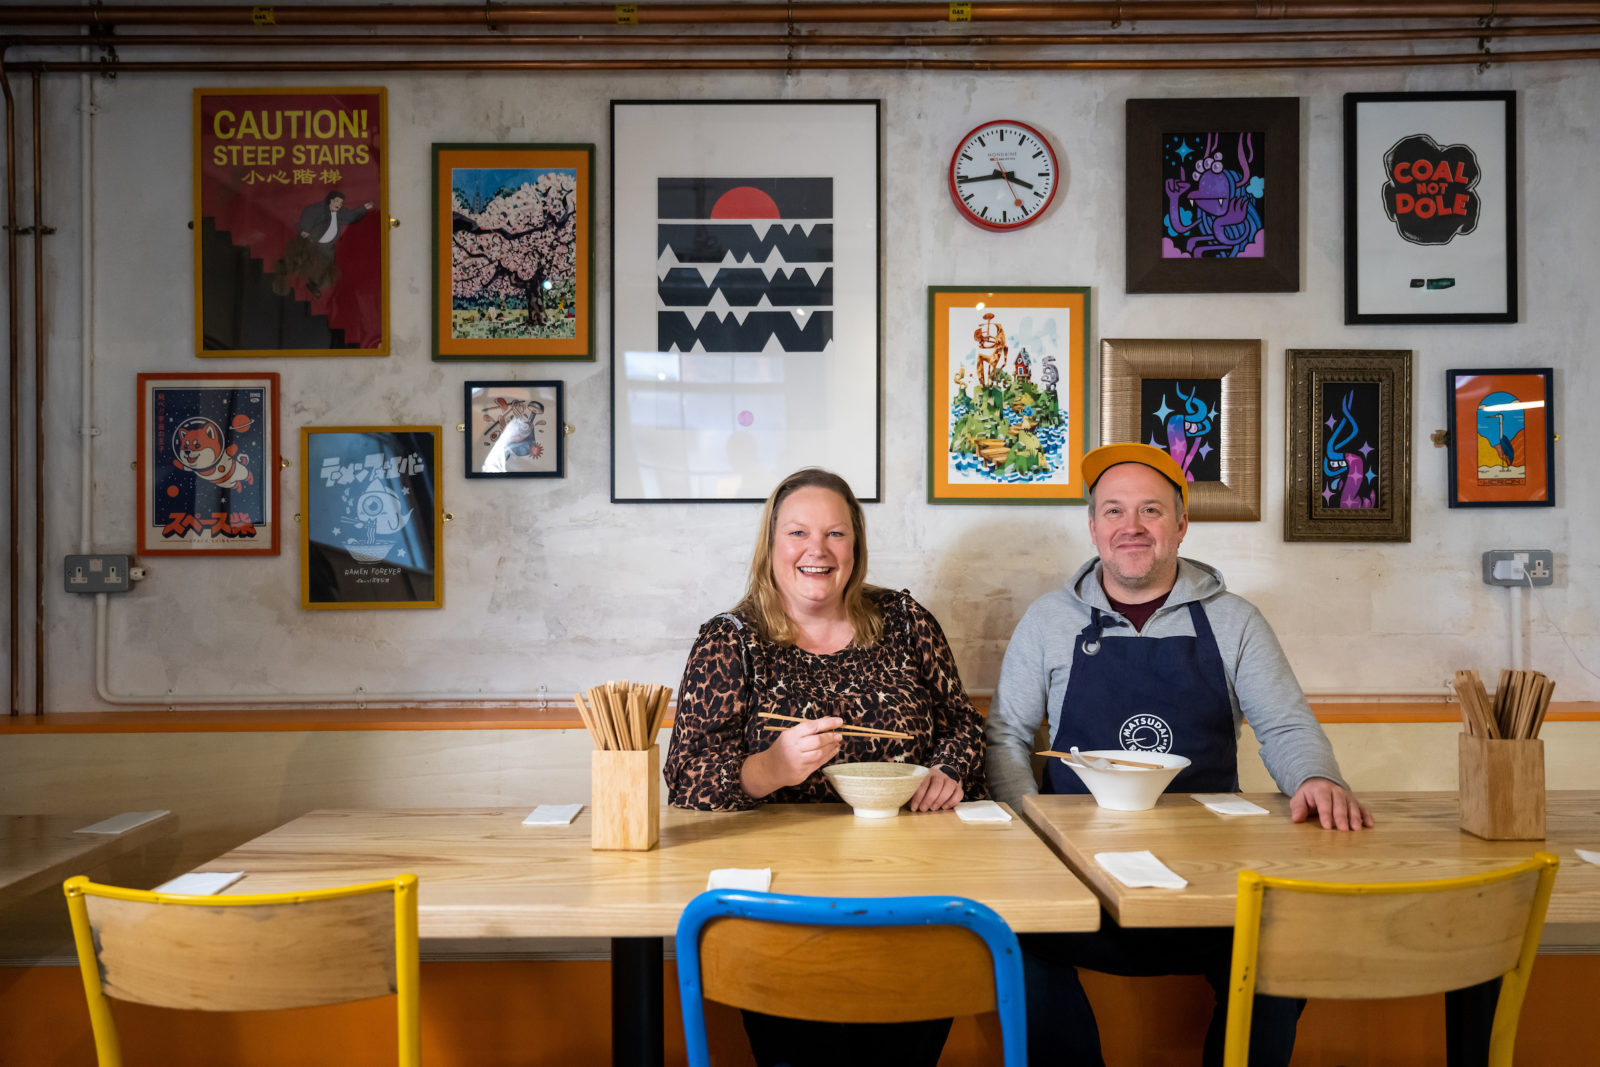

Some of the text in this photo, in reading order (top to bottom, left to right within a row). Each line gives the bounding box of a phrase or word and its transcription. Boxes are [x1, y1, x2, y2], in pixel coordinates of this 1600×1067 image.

[213, 109, 368, 140] CAUTION!
[213, 144, 370, 166] STEEP STAIRS
[241, 168, 343, 185] 小心階梯
[1393, 159, 1469, 184] COAL
[1416, 182, 1448, 195] NOT
[1395, 193, 1470, 219] DOLE
[344, 567, 402, 576] RAMEN FOREVER
[1123, 717, 1169, 738] MATSUDAI
